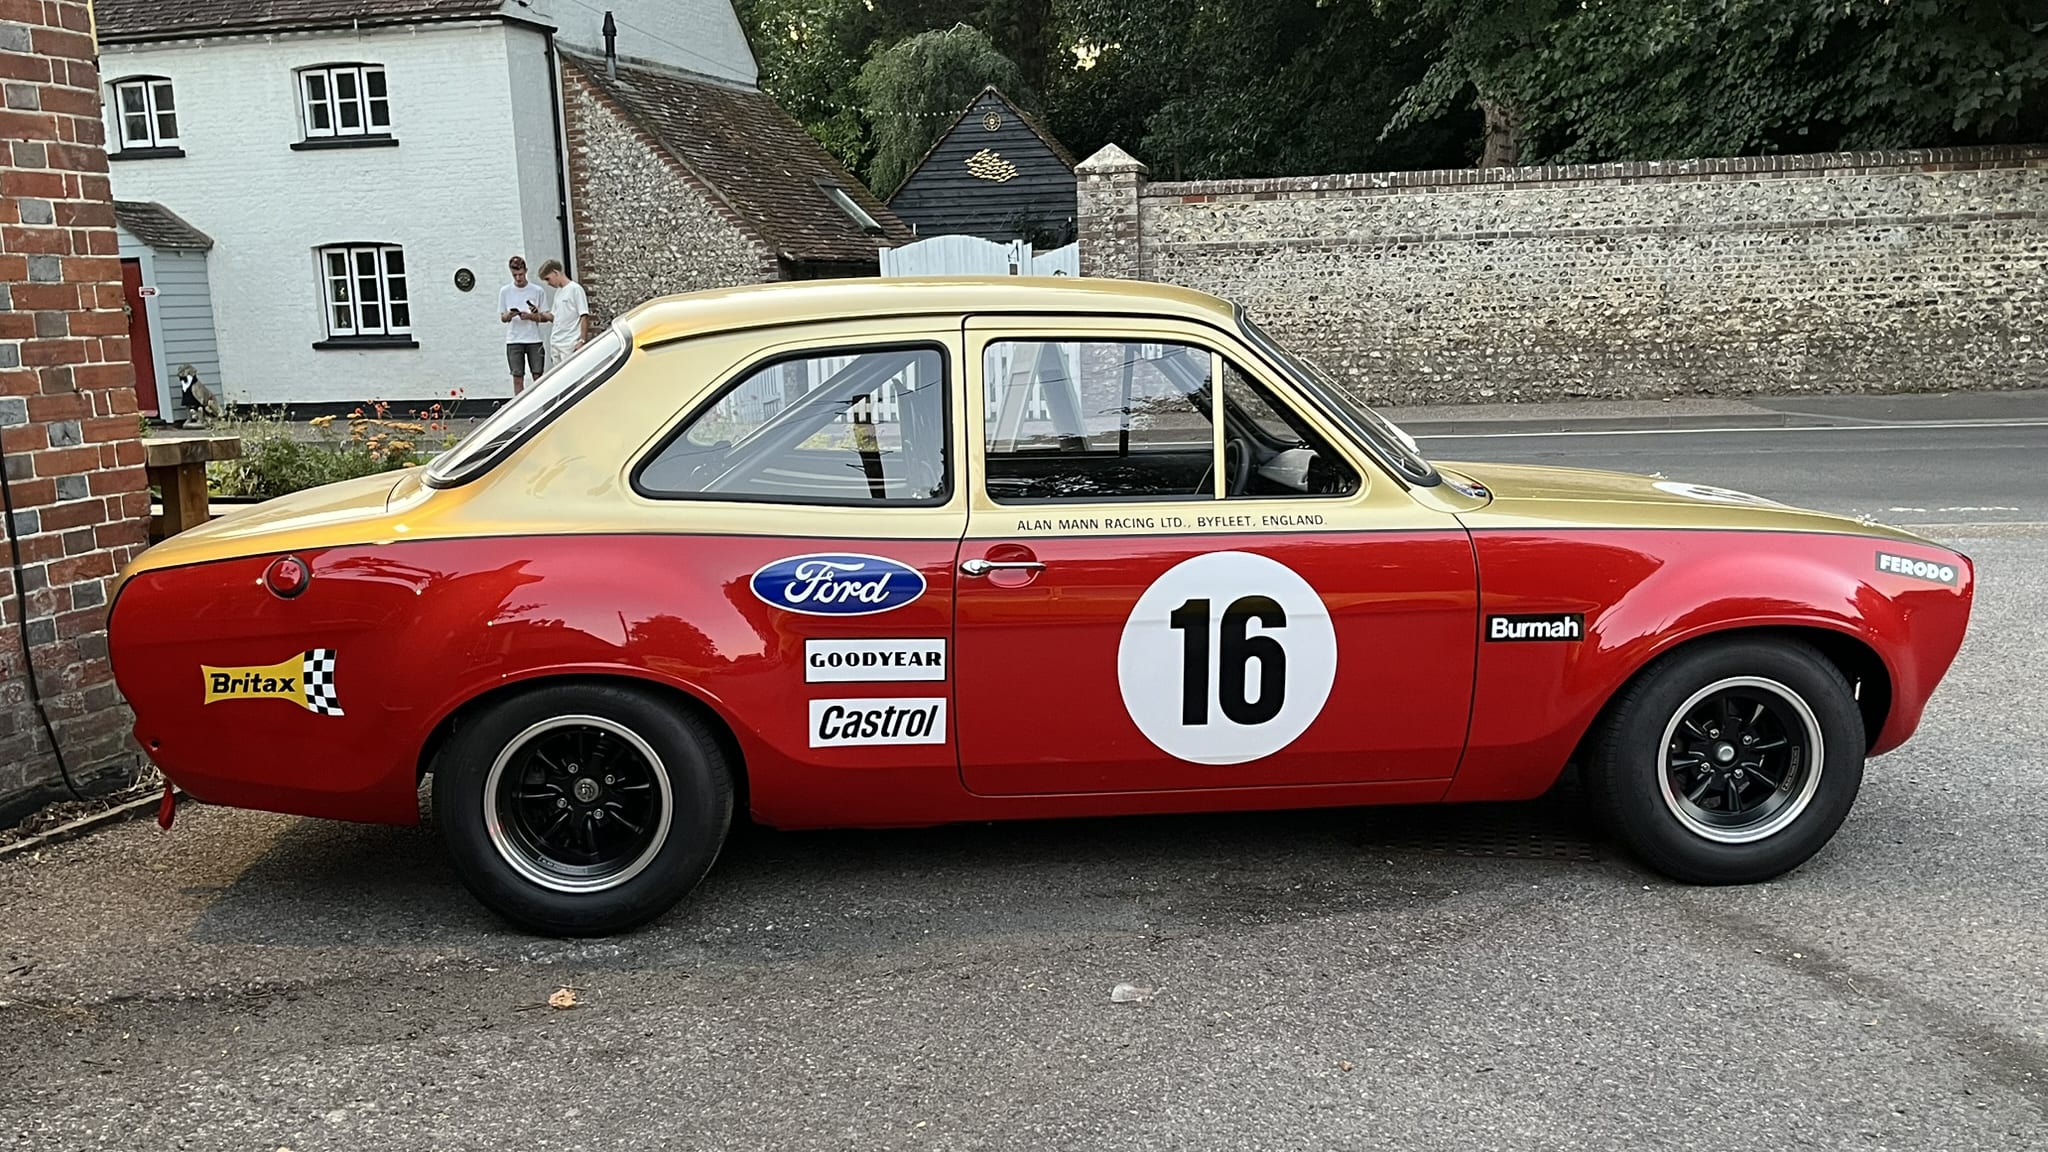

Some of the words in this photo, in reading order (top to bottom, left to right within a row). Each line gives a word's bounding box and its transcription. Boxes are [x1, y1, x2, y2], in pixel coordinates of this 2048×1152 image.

[1017, 520, 1052, 531] ALAN
[1058, 519, 1099, 530] MANN
[1105, 518, 1155, 529] RACING
[1197, 516, 1256, 527] BYFLEET,
[1880, 554, 1954, 582] FERODO
[784, 560, 893, 604] Ford
[1491, 616, 1579, 639] Burmah
[810, 651, 942, 668] GOODYEAR
[1170, 594, 1287, 726] 16
[210, 672, 296, 694] Britax
[818, 705, 939, 740] Castrol
